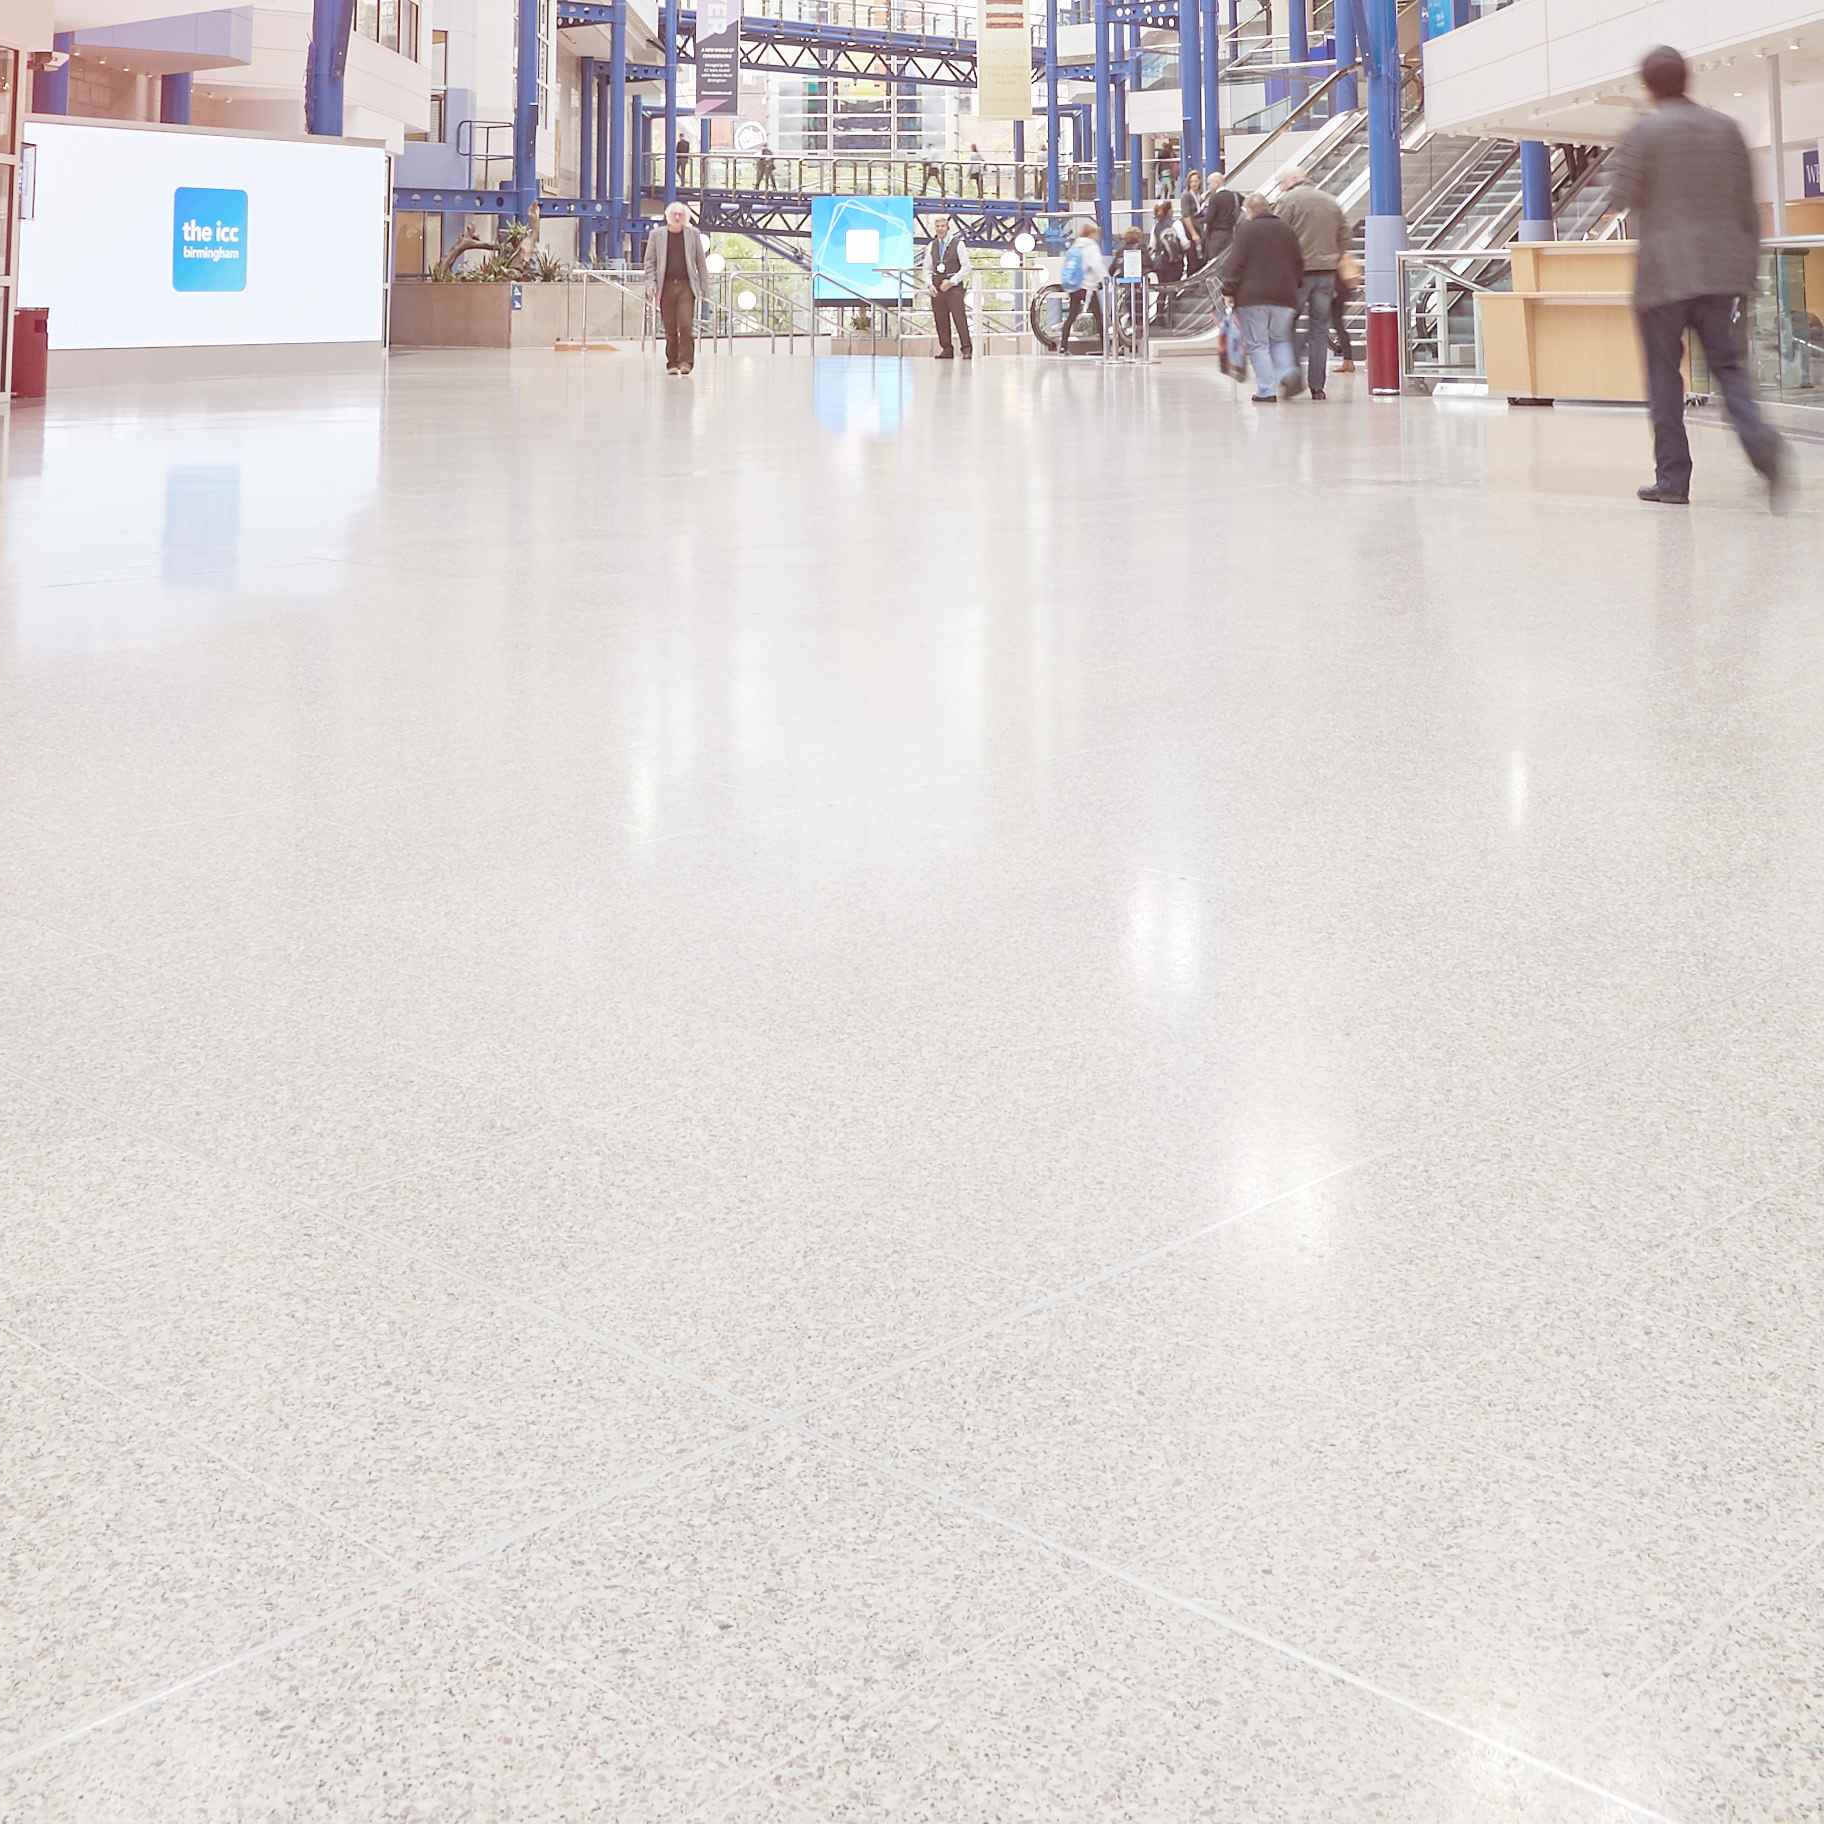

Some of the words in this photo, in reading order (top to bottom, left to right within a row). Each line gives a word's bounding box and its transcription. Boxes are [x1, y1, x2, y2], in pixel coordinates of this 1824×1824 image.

[182, 219, 212, 242] the
[216, 220, 240, 242] icc
[183, 245, 240, 262] birmingham
